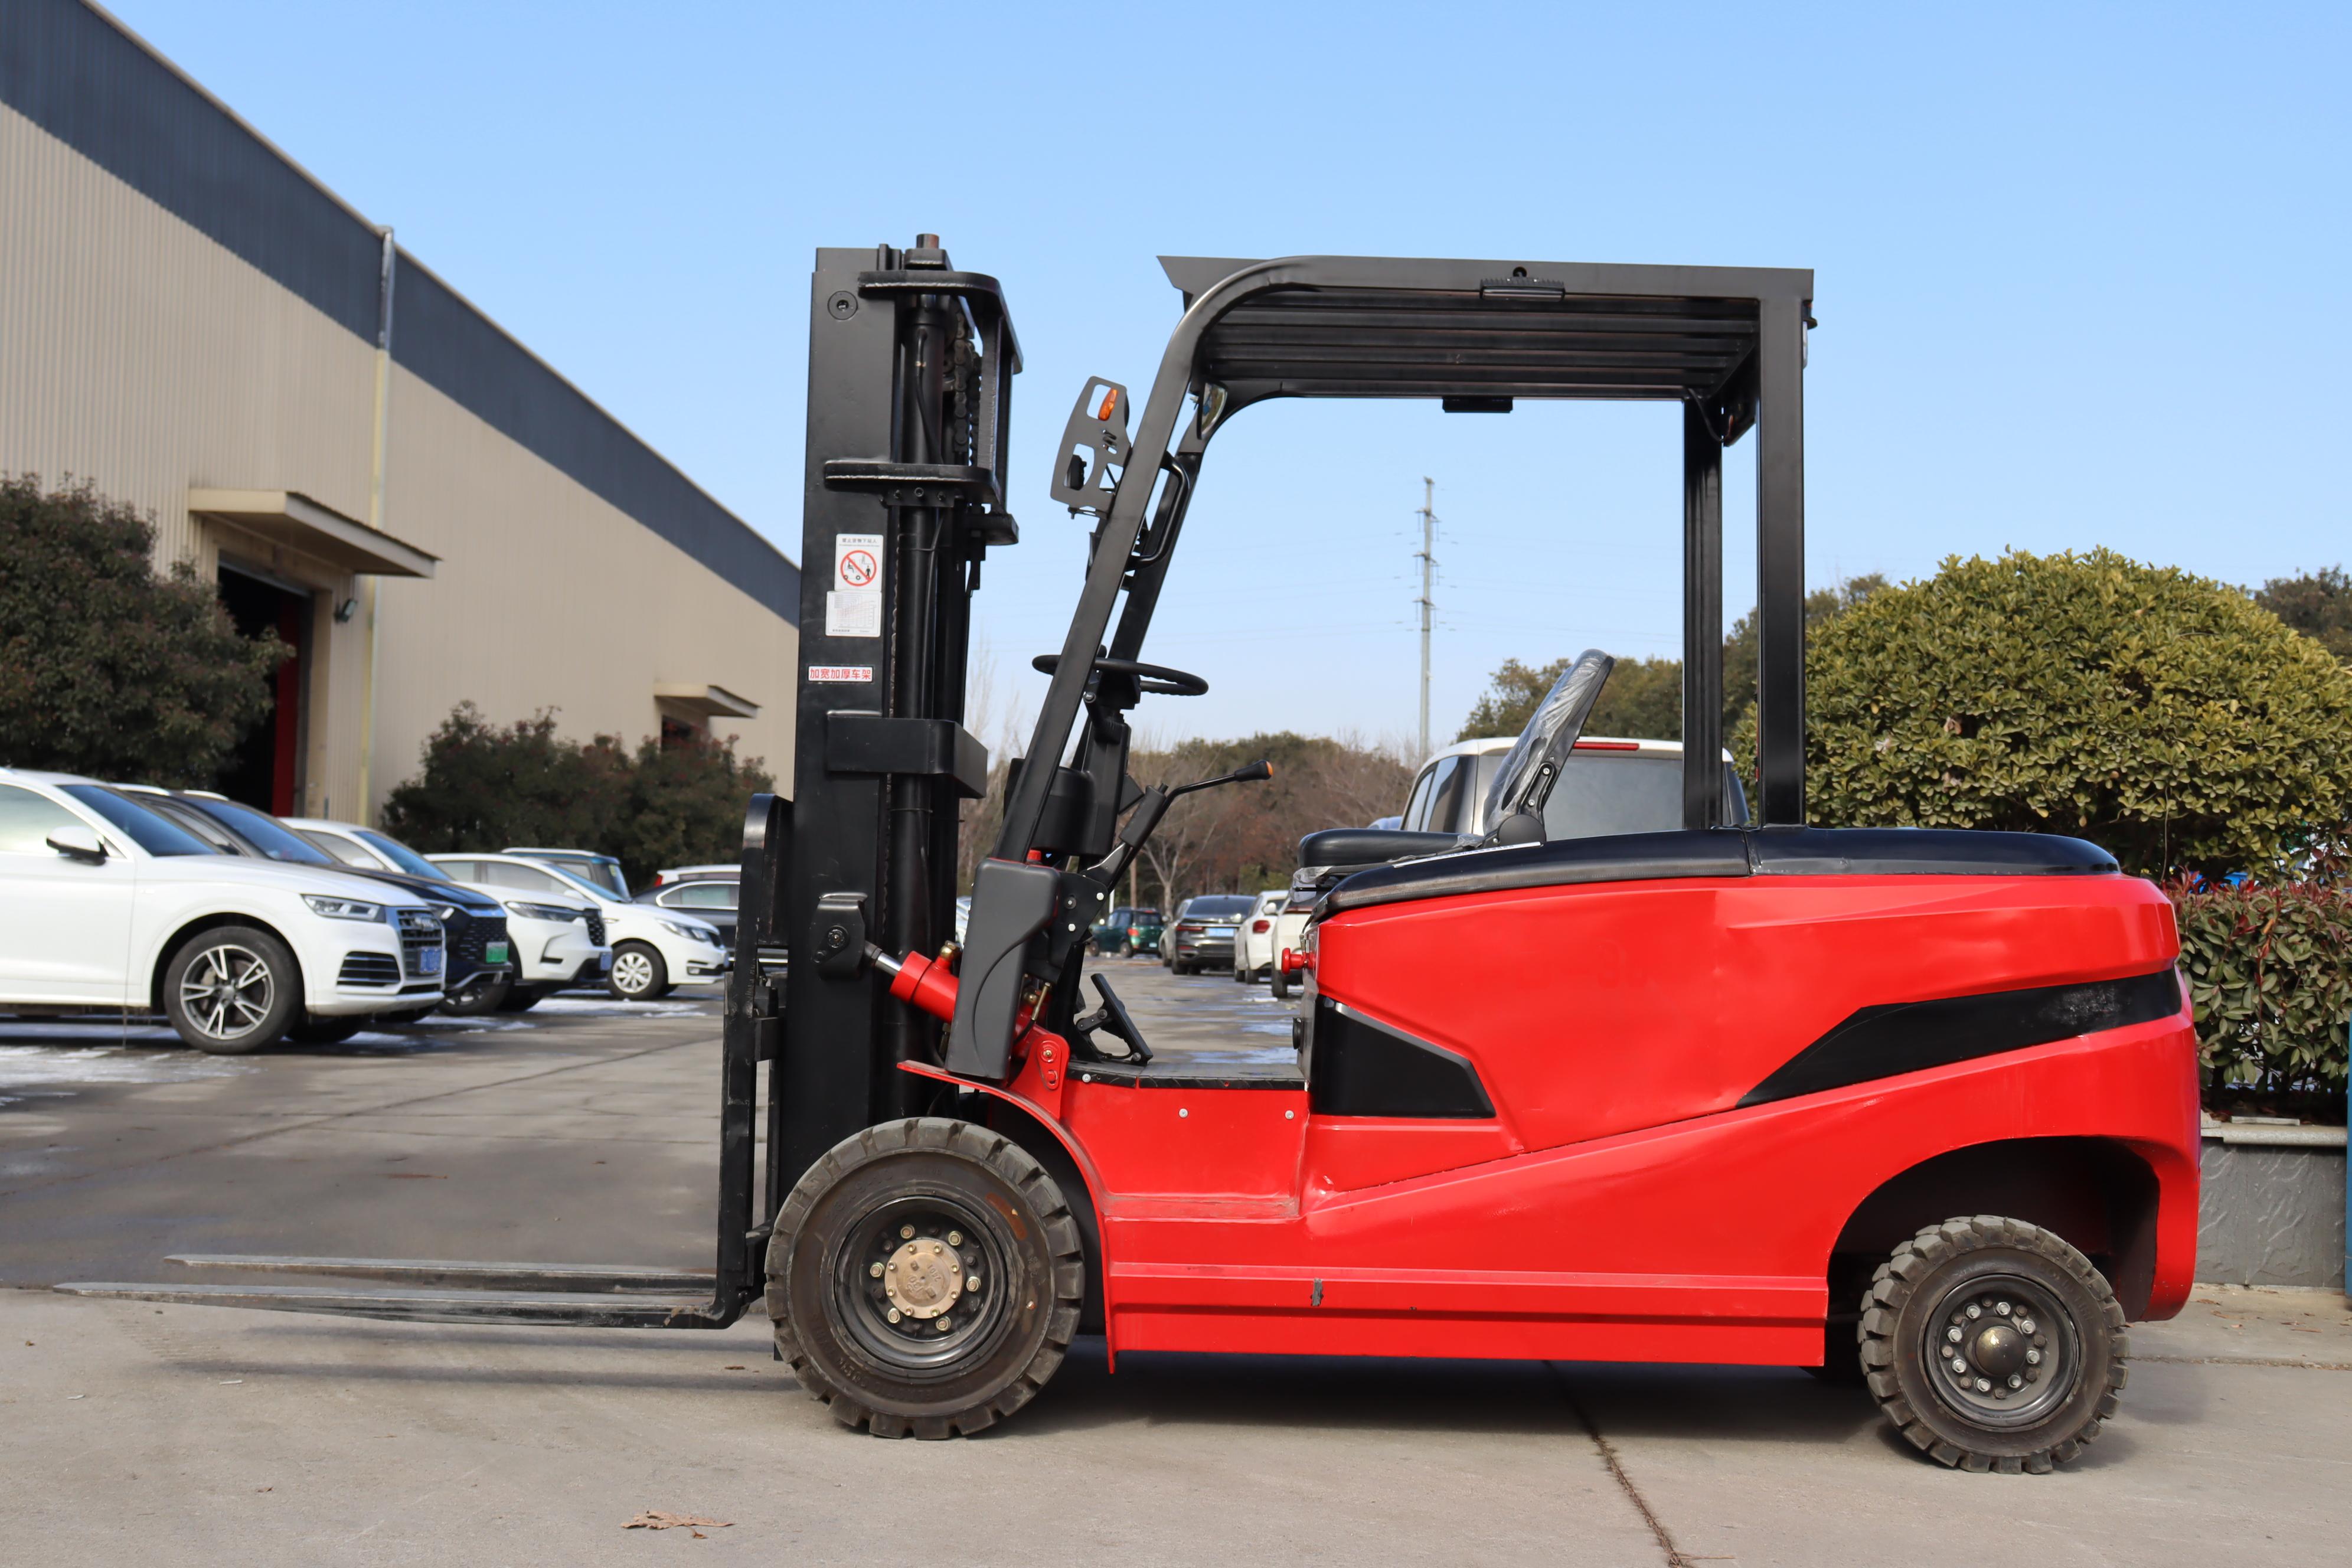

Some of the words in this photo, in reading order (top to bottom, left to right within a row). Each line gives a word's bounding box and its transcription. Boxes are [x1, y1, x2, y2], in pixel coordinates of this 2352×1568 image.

[810, 668, 871, 680] 加宽加厚车架
